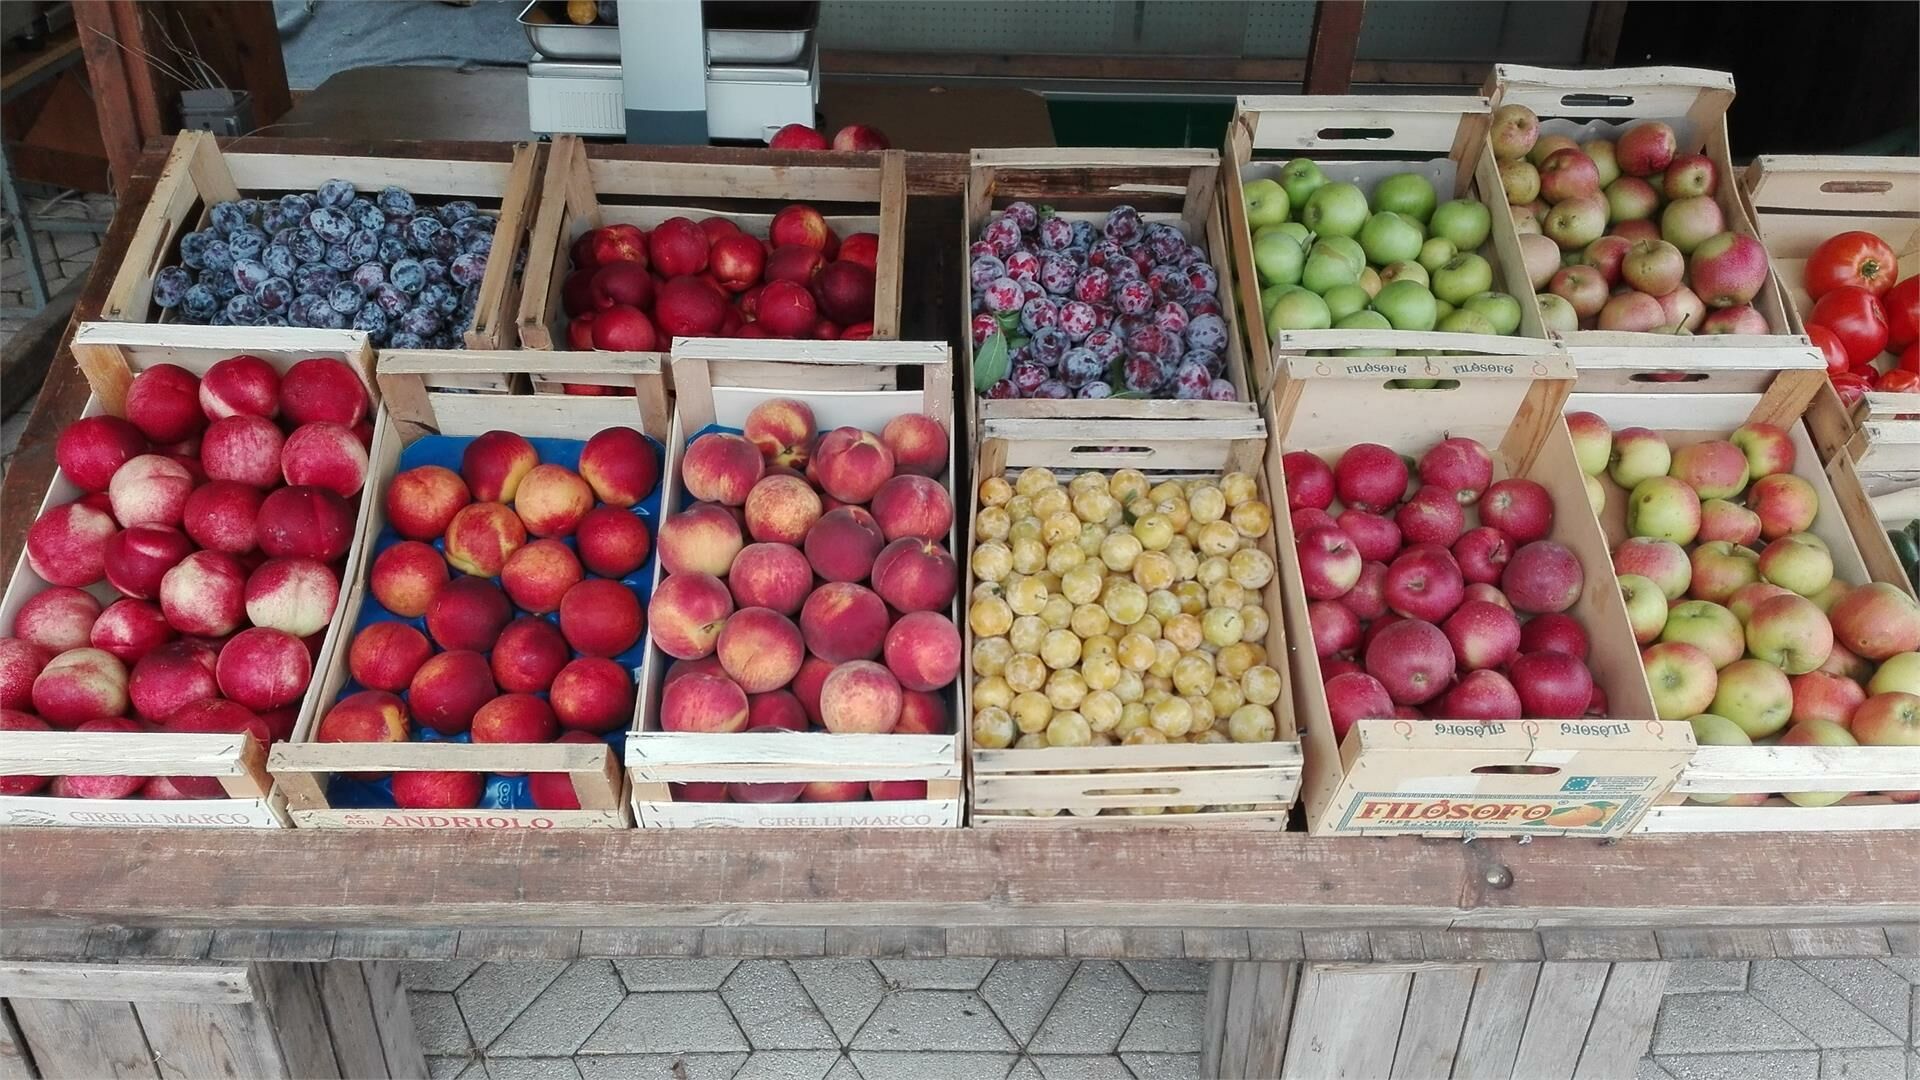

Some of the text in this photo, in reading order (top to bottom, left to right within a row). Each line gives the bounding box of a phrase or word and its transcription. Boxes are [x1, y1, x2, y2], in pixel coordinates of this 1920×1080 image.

[69, 811, 158, 825] GIRELLI
[164, 813, 250, 825] MARCO
[382, 814, 554, 829] ANDRIOLO
[758, 814, 931, 826] GIRELLI MARCO
